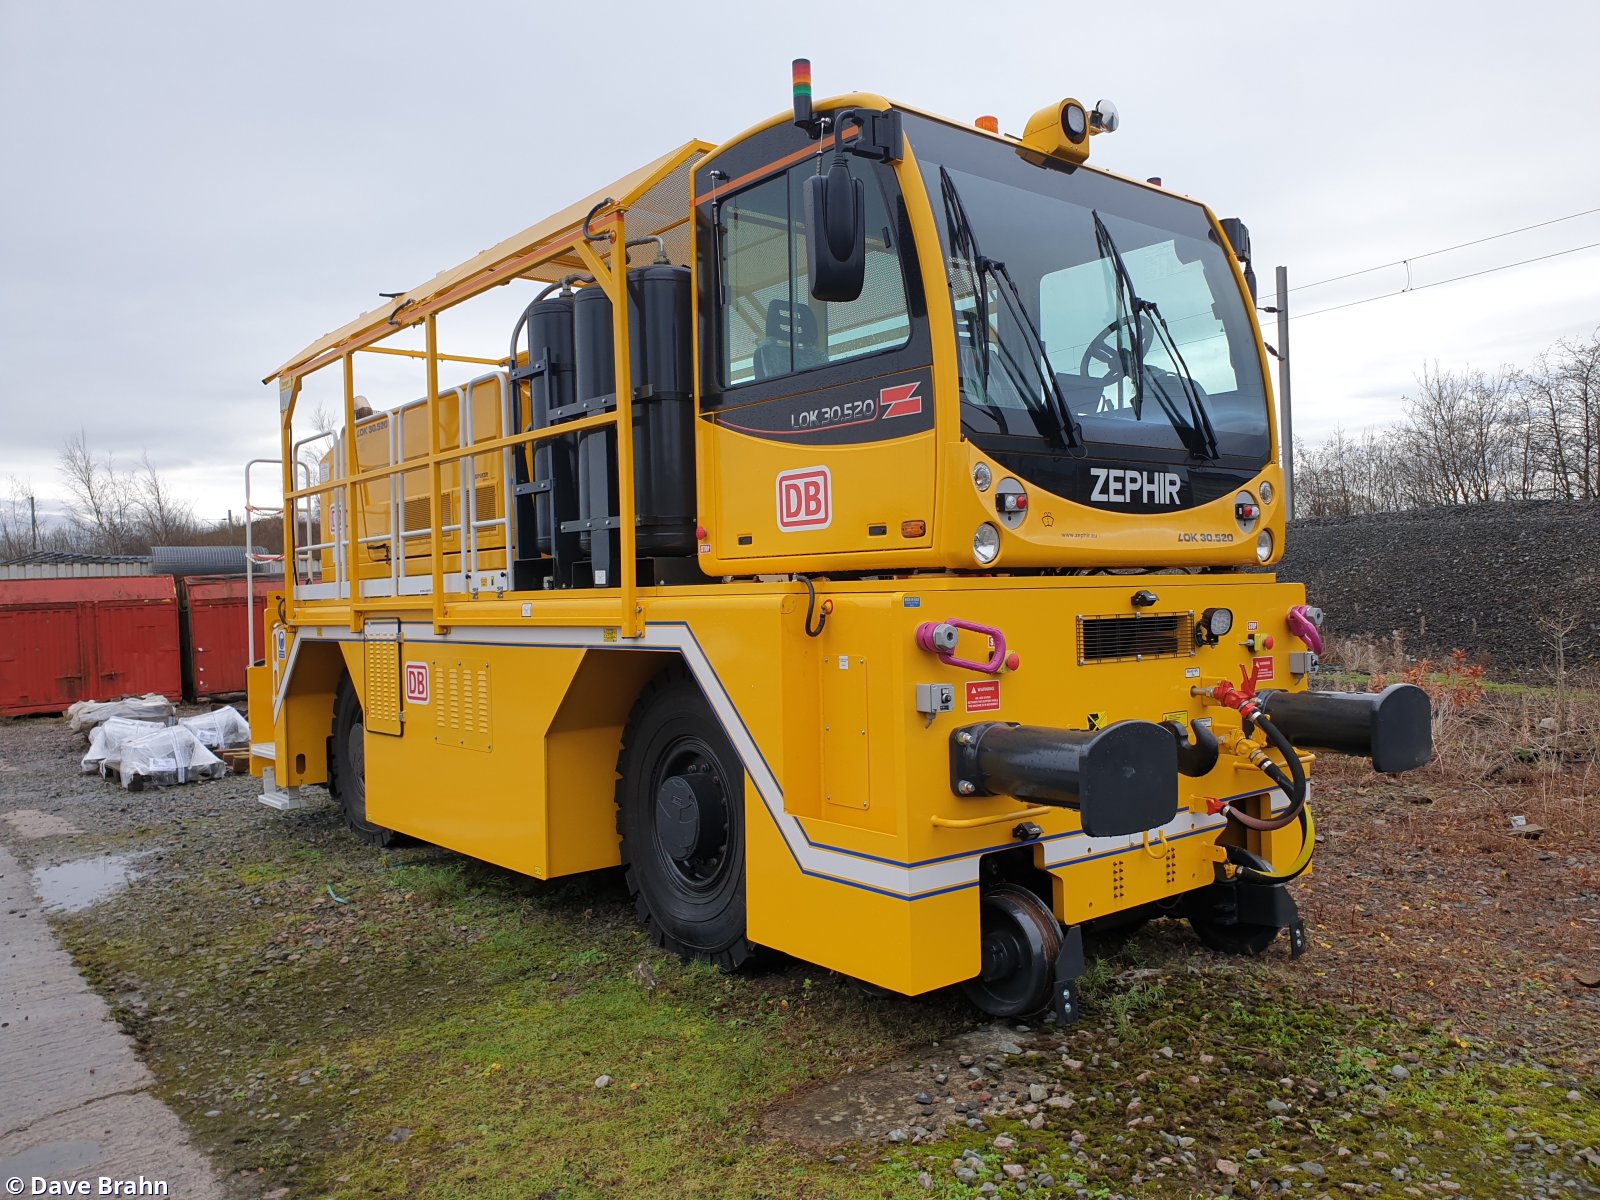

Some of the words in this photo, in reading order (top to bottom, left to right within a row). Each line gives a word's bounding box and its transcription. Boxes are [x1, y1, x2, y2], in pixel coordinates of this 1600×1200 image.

[791, 409, 819, 428] LOK
[1090, 467, 1181, 505] ZEPHIR
[784, 480, 822, 519] DB
[1177, 533, 1198, 543] LOK
[1200, 533, 1234, 543] 30.520
[1248, 622, 1257, 630] STOP
[409, 670, 425, 695] DB
